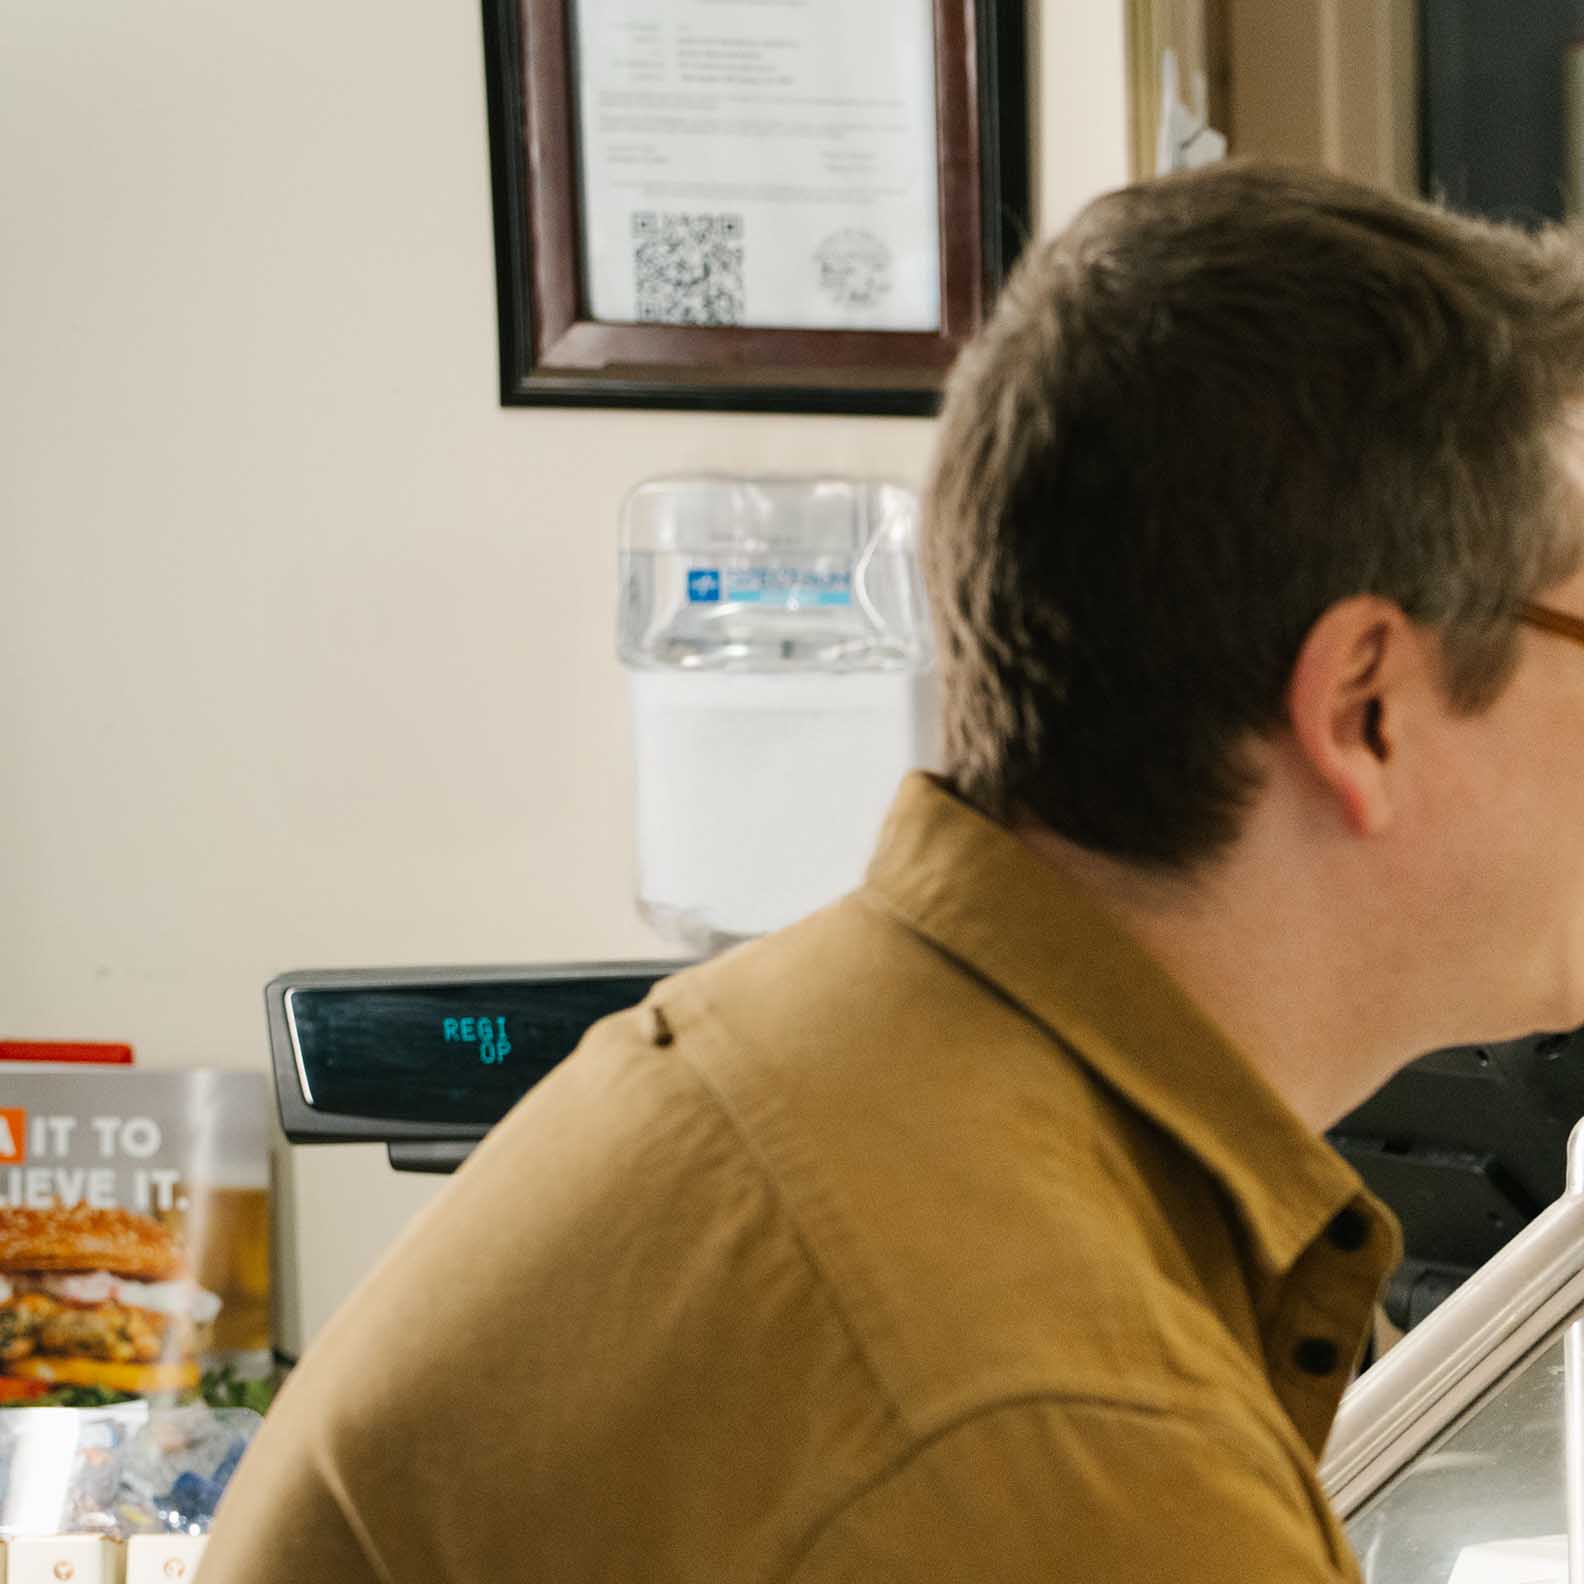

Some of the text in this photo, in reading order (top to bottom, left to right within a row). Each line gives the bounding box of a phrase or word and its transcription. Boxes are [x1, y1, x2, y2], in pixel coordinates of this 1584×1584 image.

[30, 1116, 77, 1158] IT
[91, 1115, 163, 1159] TO
[133, 1169, 191, 1211] IT.
